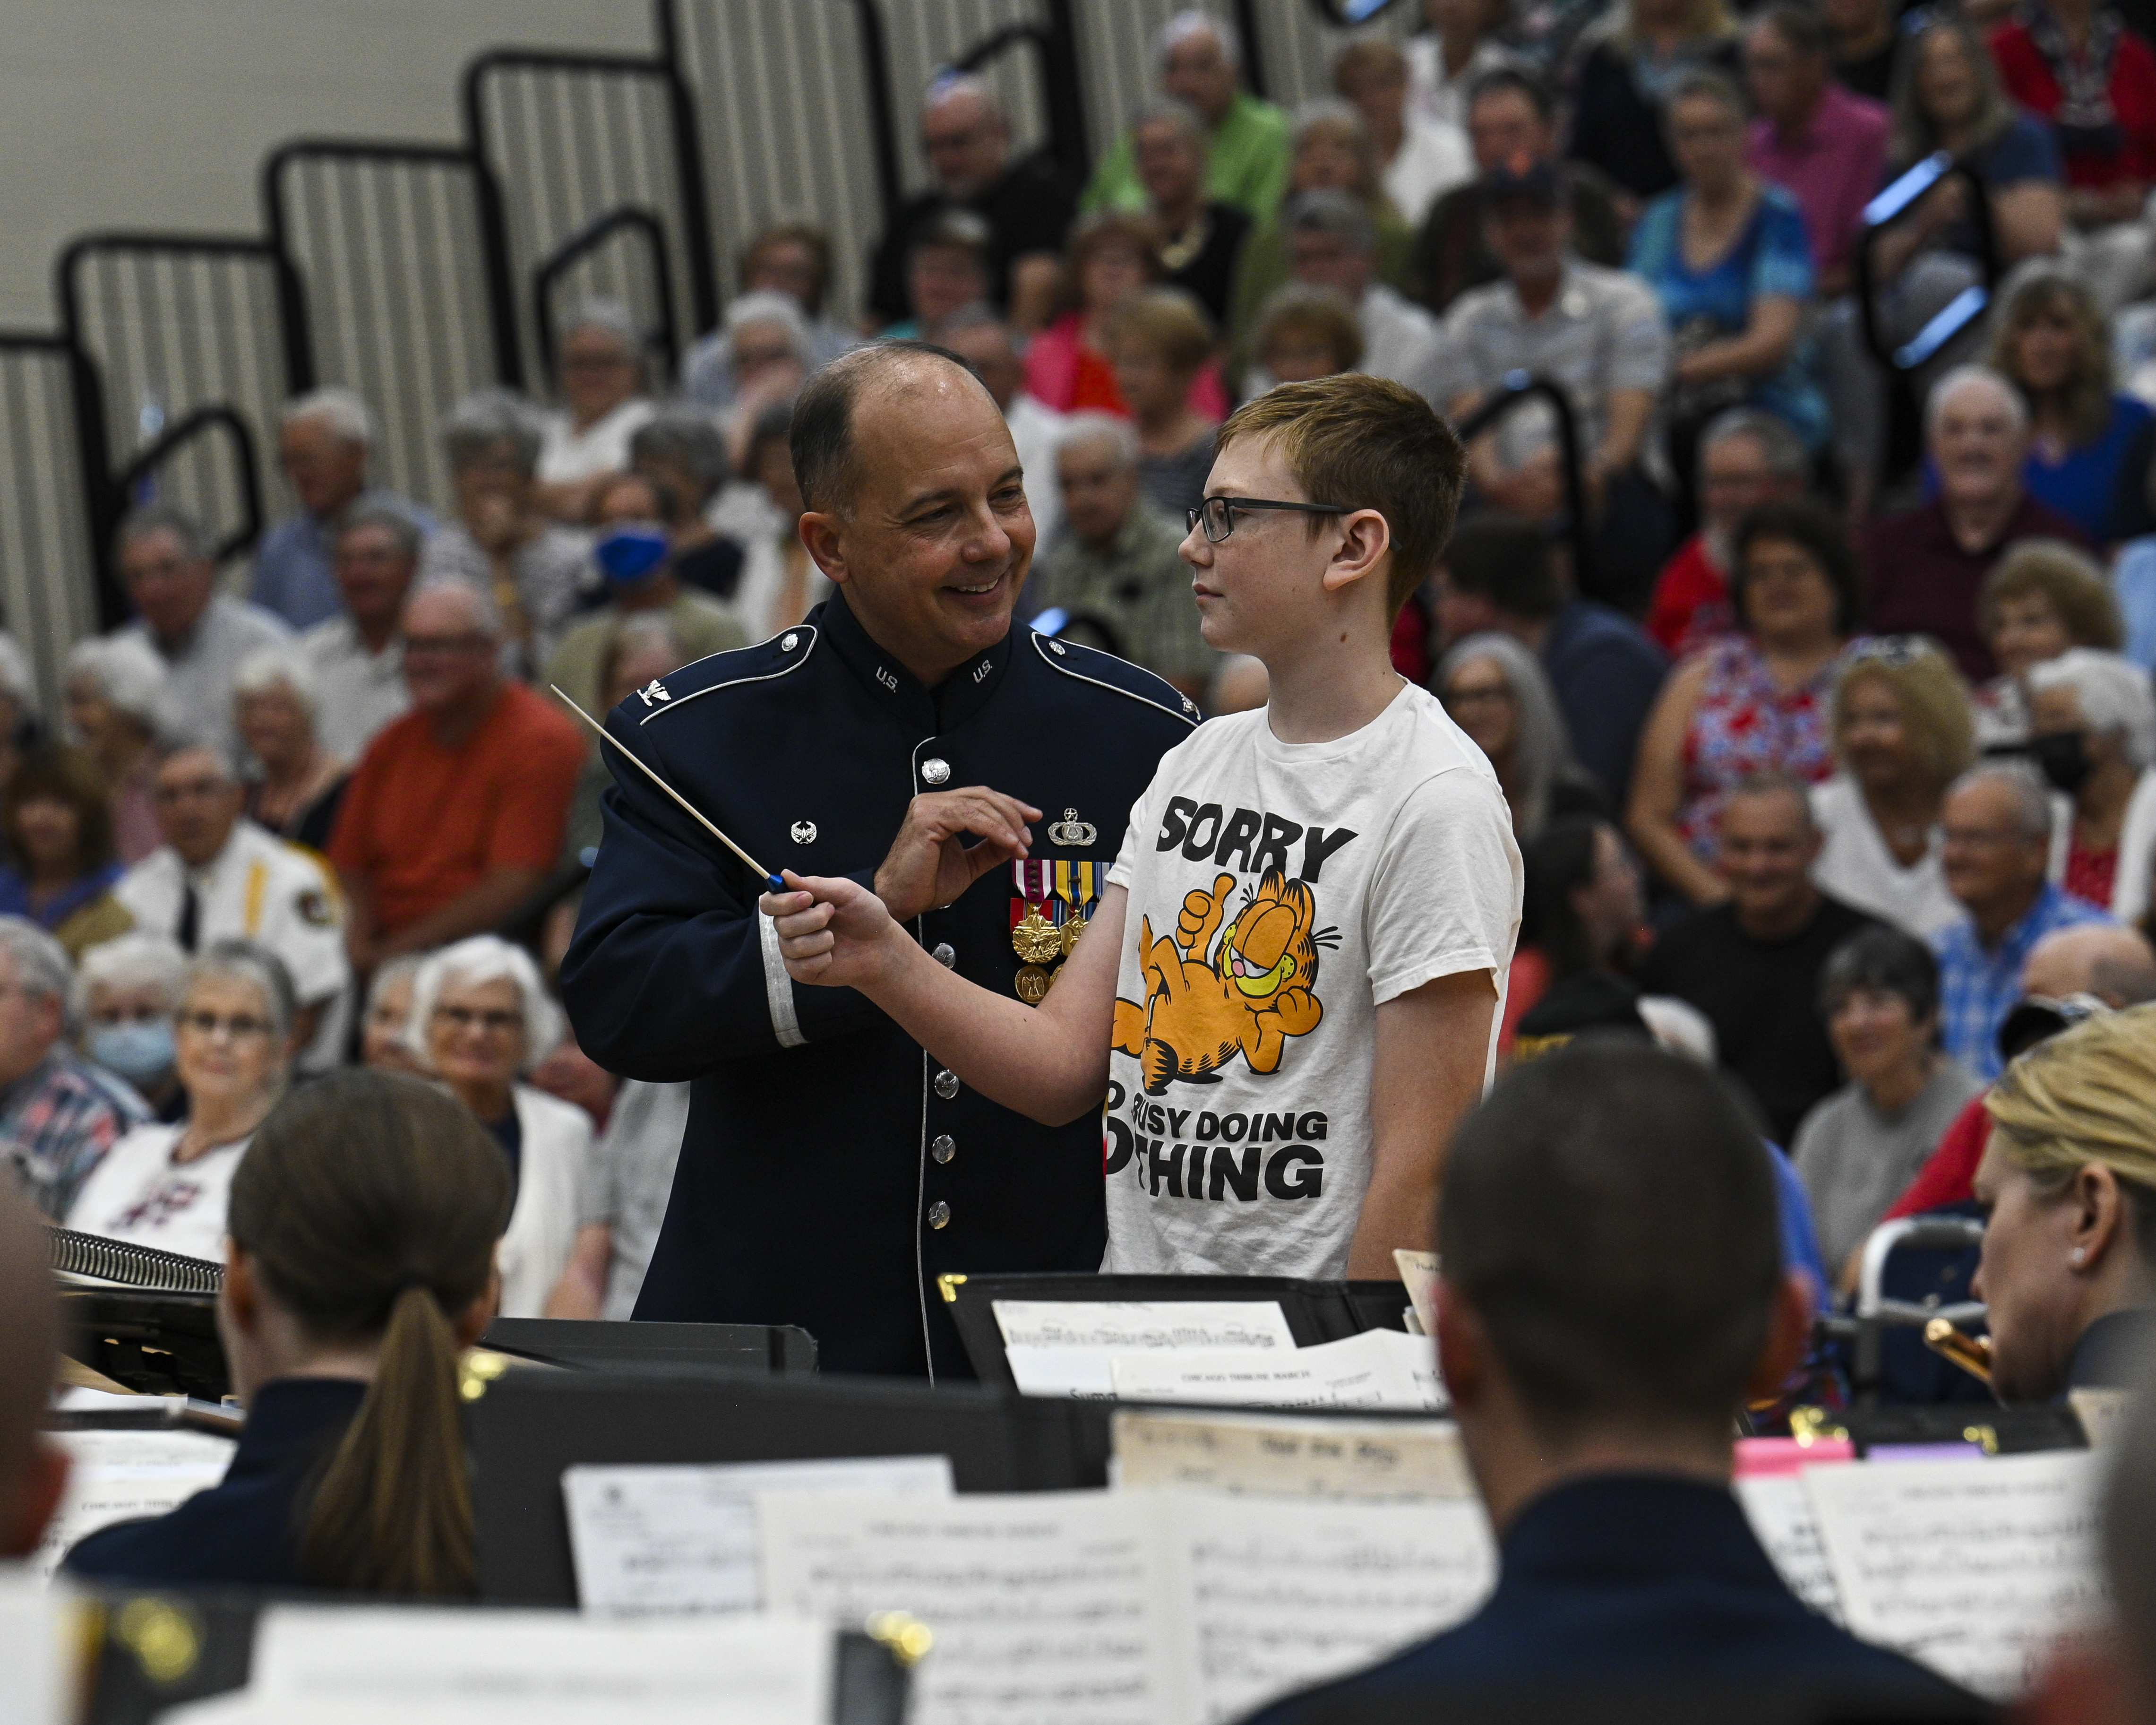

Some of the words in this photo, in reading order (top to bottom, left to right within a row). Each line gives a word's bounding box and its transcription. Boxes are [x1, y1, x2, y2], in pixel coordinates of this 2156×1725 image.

[876, 666, 898, 693] U.S.
[973, 660, 993, 683] U.S.
[1156, 796, 1359, 883] SORRY
[1196, 1111, 1328, 1142] DOING
